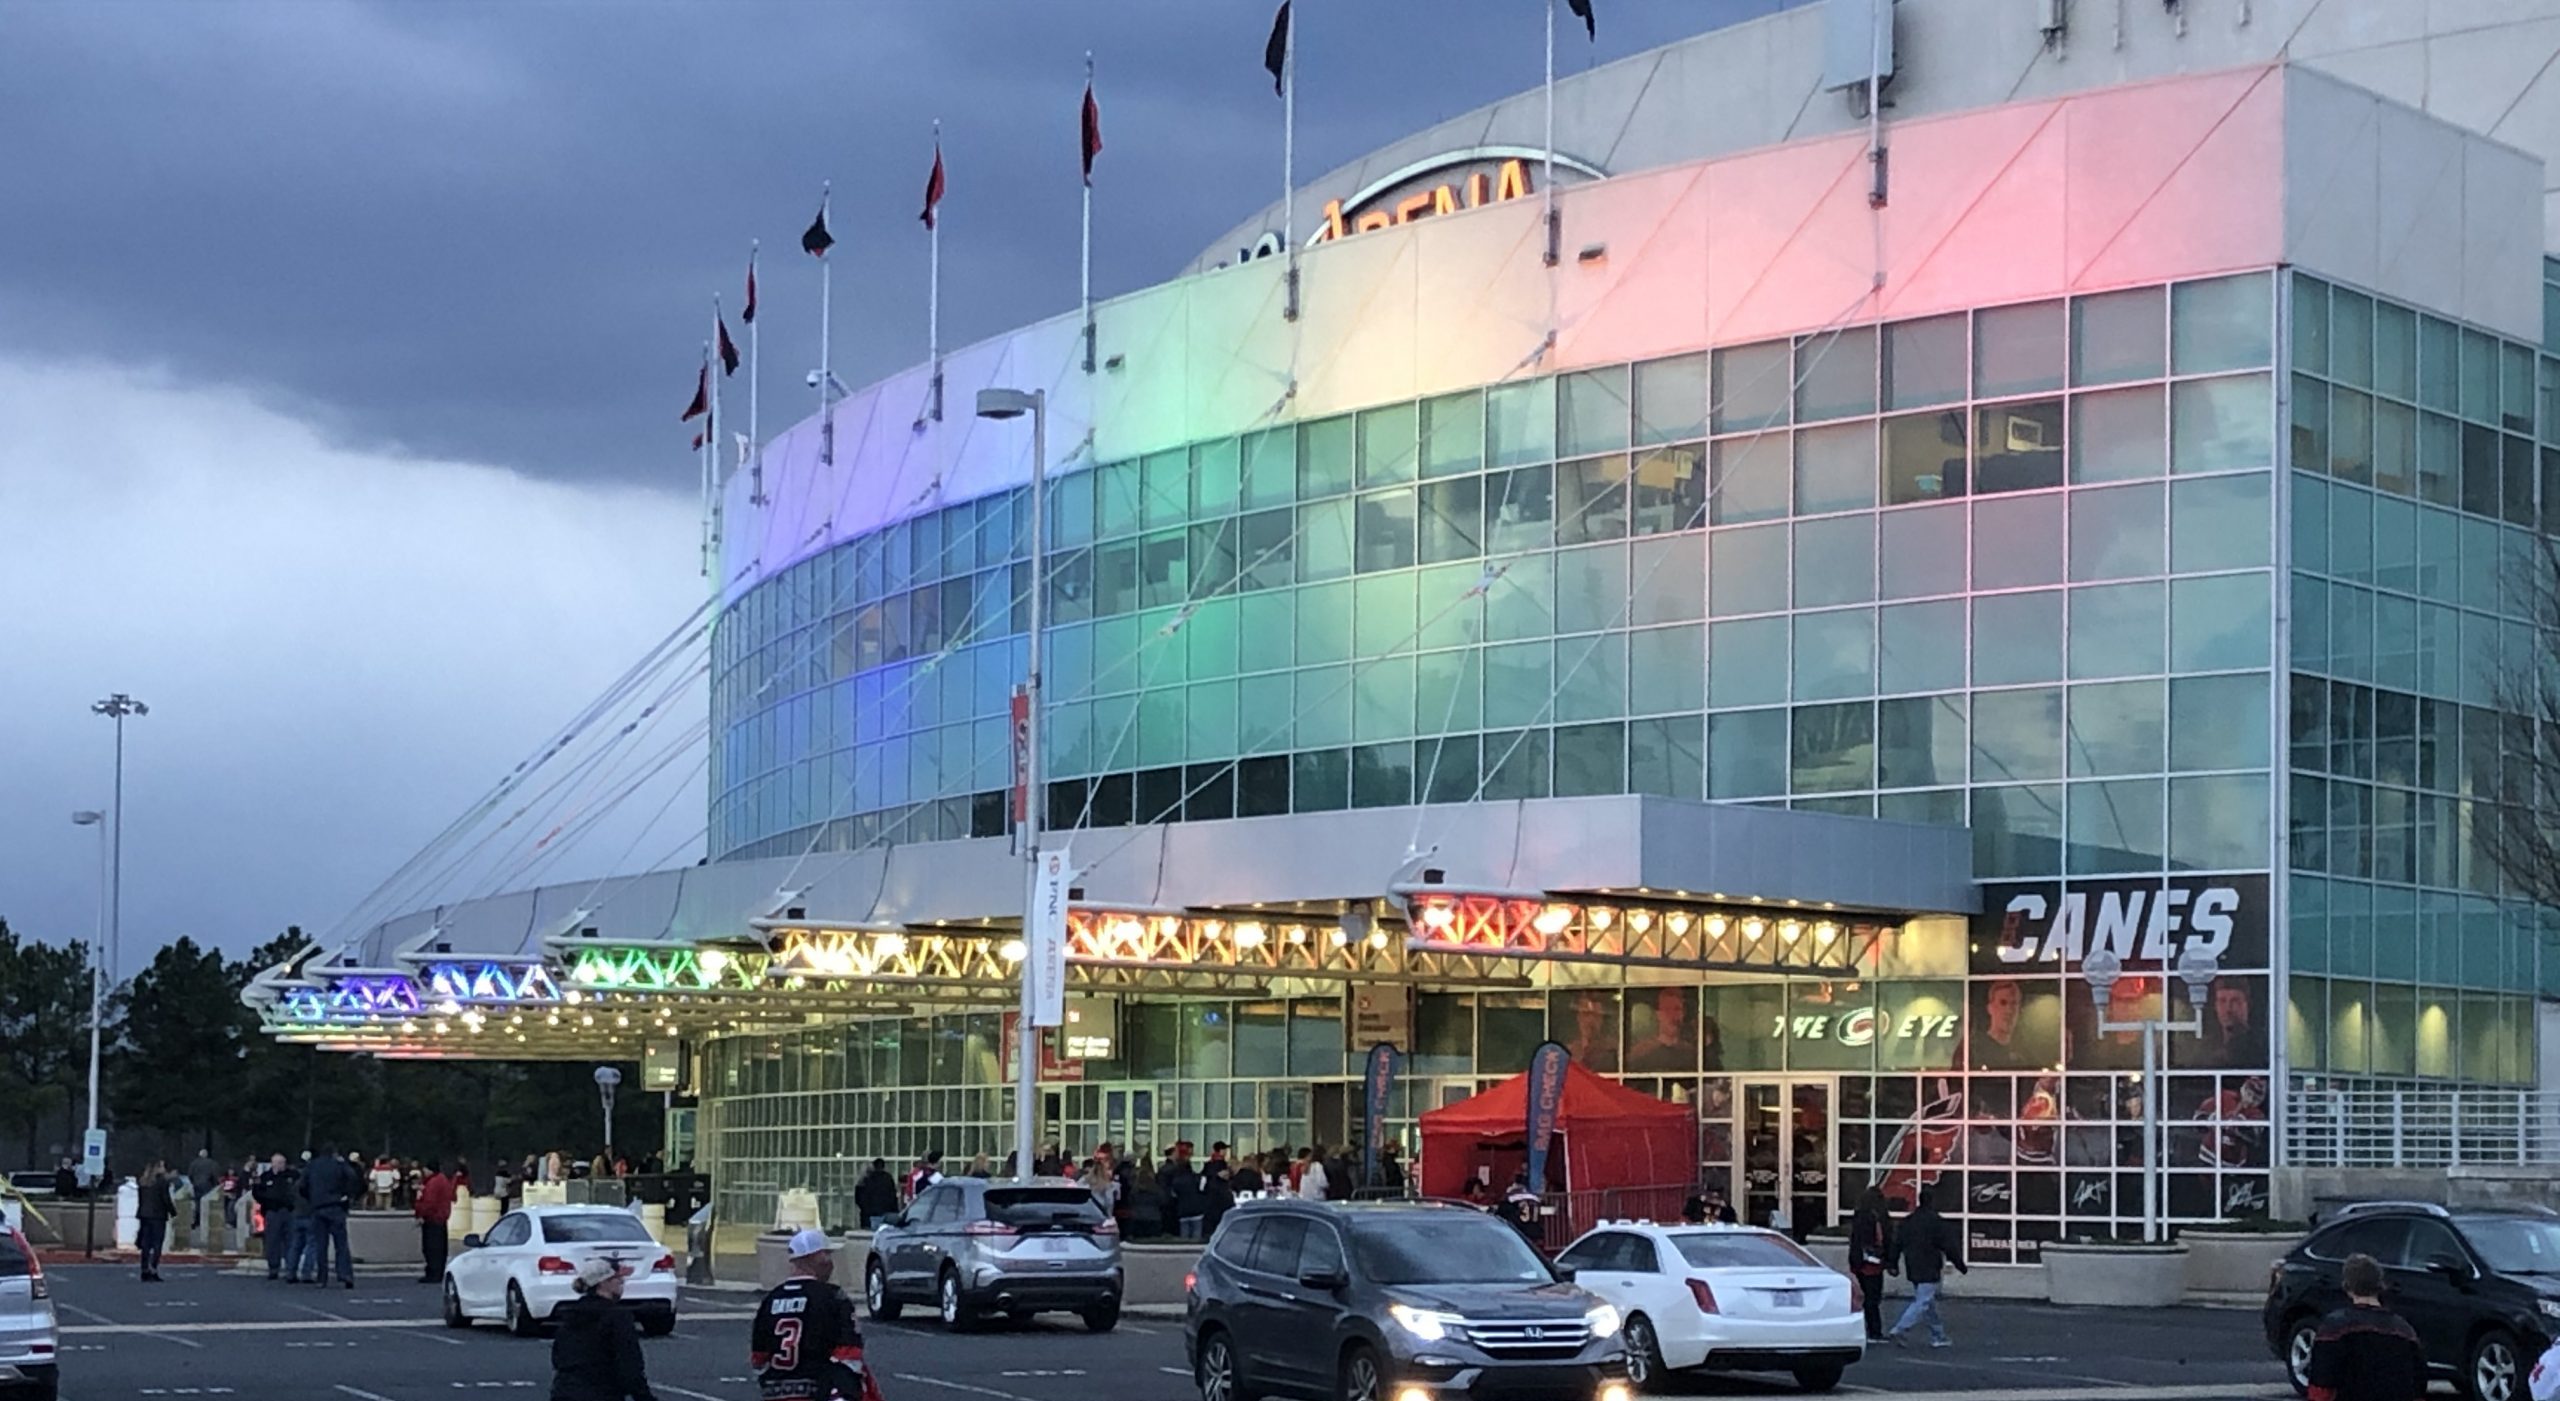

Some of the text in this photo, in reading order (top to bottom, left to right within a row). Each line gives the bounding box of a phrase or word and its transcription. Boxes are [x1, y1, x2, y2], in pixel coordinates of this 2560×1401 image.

[1998, 888, 2240, 963] CANES
[1772, 1015, 1959, 1039] THE EYE
[1540, 1050, 1560, 1110] CHECK
[771, 1317, 803, 1371] 3
